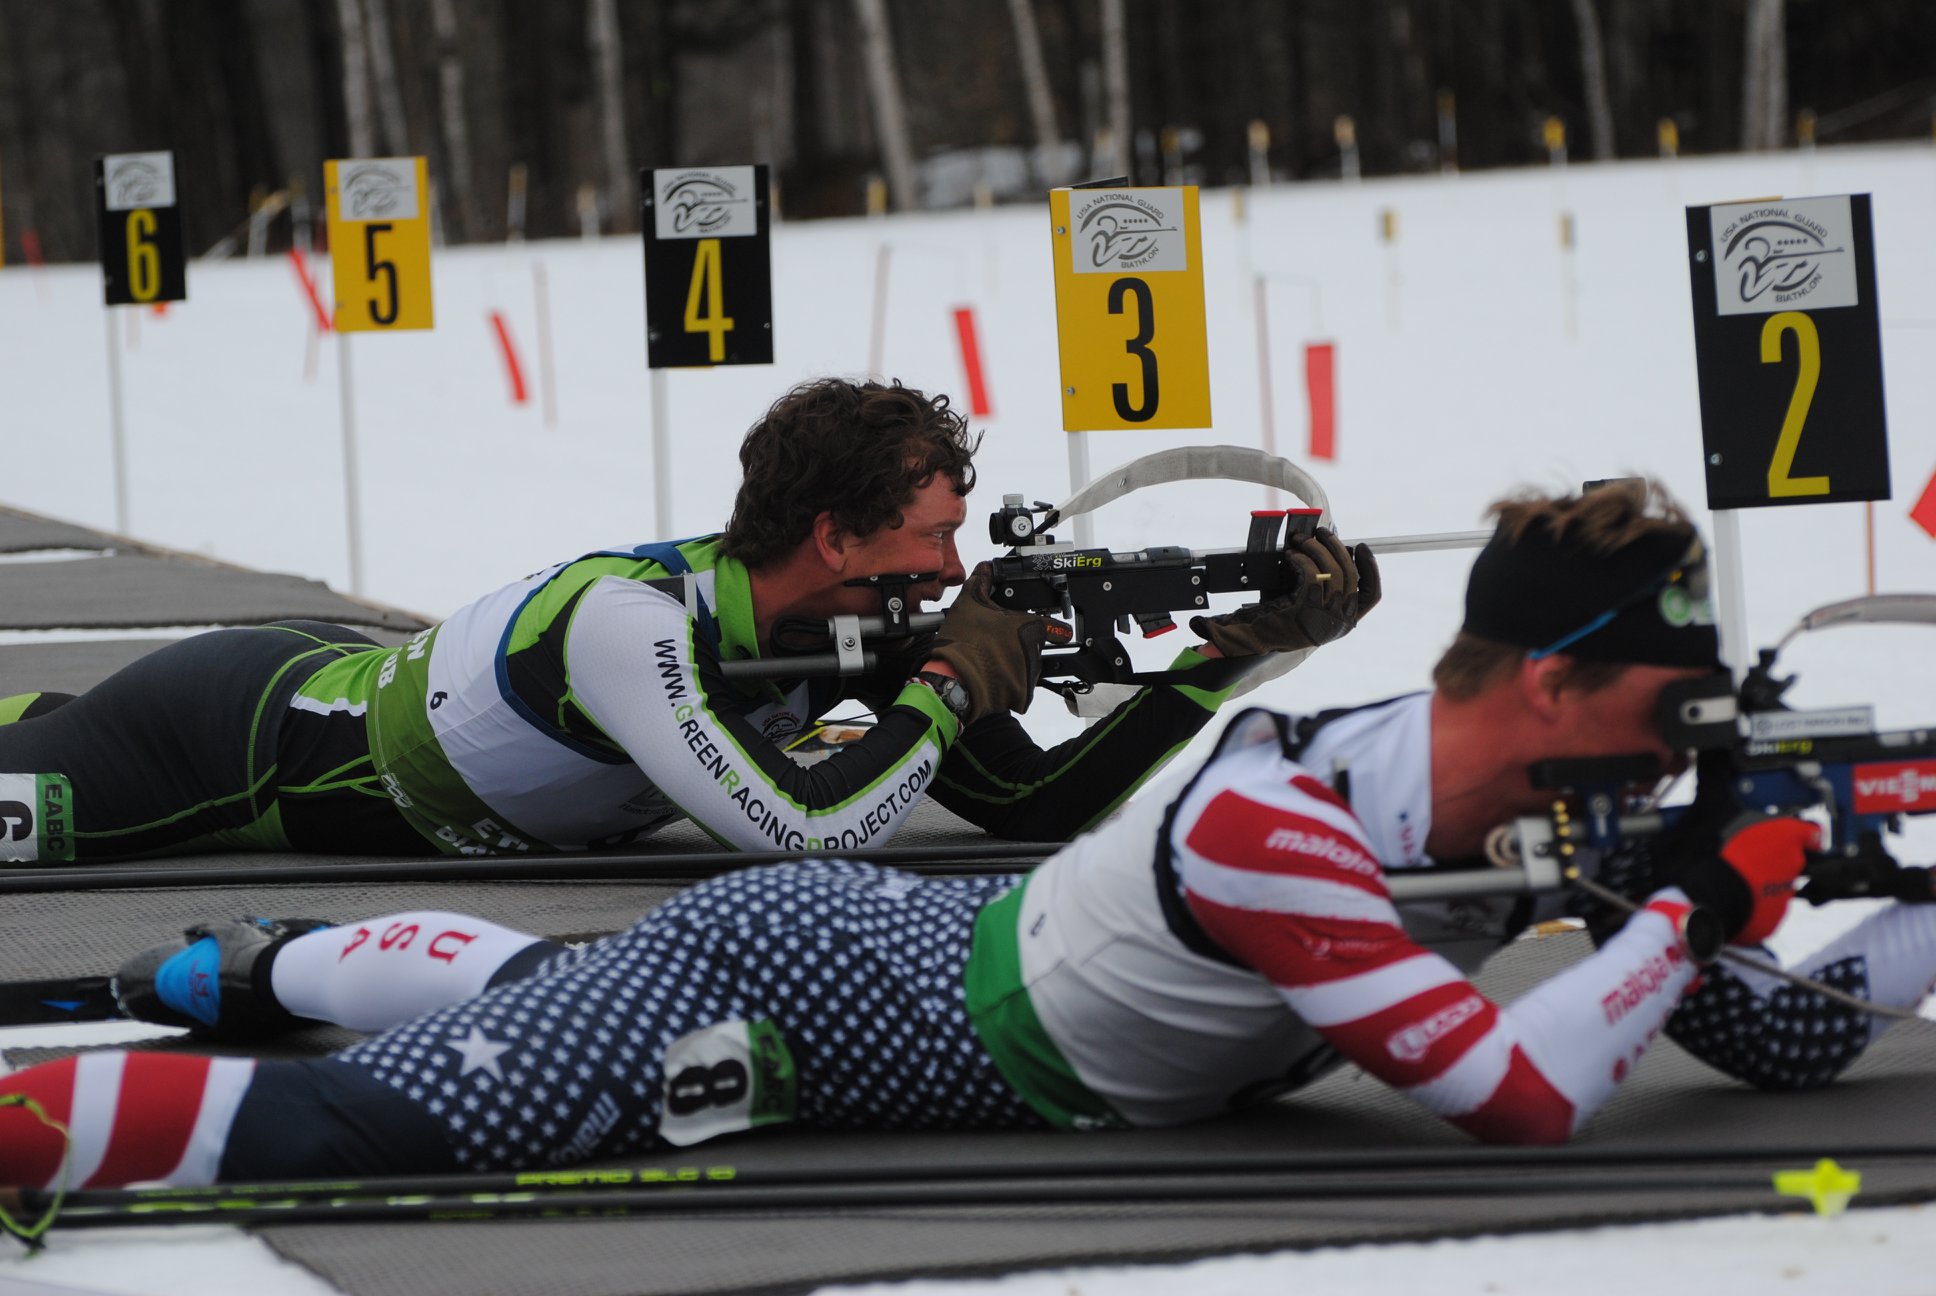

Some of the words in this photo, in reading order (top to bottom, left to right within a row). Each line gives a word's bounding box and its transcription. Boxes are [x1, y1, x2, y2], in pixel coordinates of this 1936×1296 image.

[1077, 203, 1093, 219] USA
[1093, 193, 1134, 206] NATIONAL
[1136, 199, 1165, 219] GUARD
[1721, 222, 1739, 243] USA
[1740, 208, 1789, 223] NATIONAL
[1794, 214, 1828, 238] GUARD
[126, 208, 161, 301] 6
[364, 223, 399, 326] 5
[1121, 246, 1159, 269] BIATHLON
[684, 239, 734, 362] 4
[1775, 273, 1822, 303] BIATHLON
[1108, 277, 1159, 422] 3
[1760, 311, 1830, 497] 2
[1053, 556, 1102, 569] SkiErg
[45, 784, 65, 851] EABC
[338, 922, 479, 966] USA
[668, 1058, 748, 1117] 8
